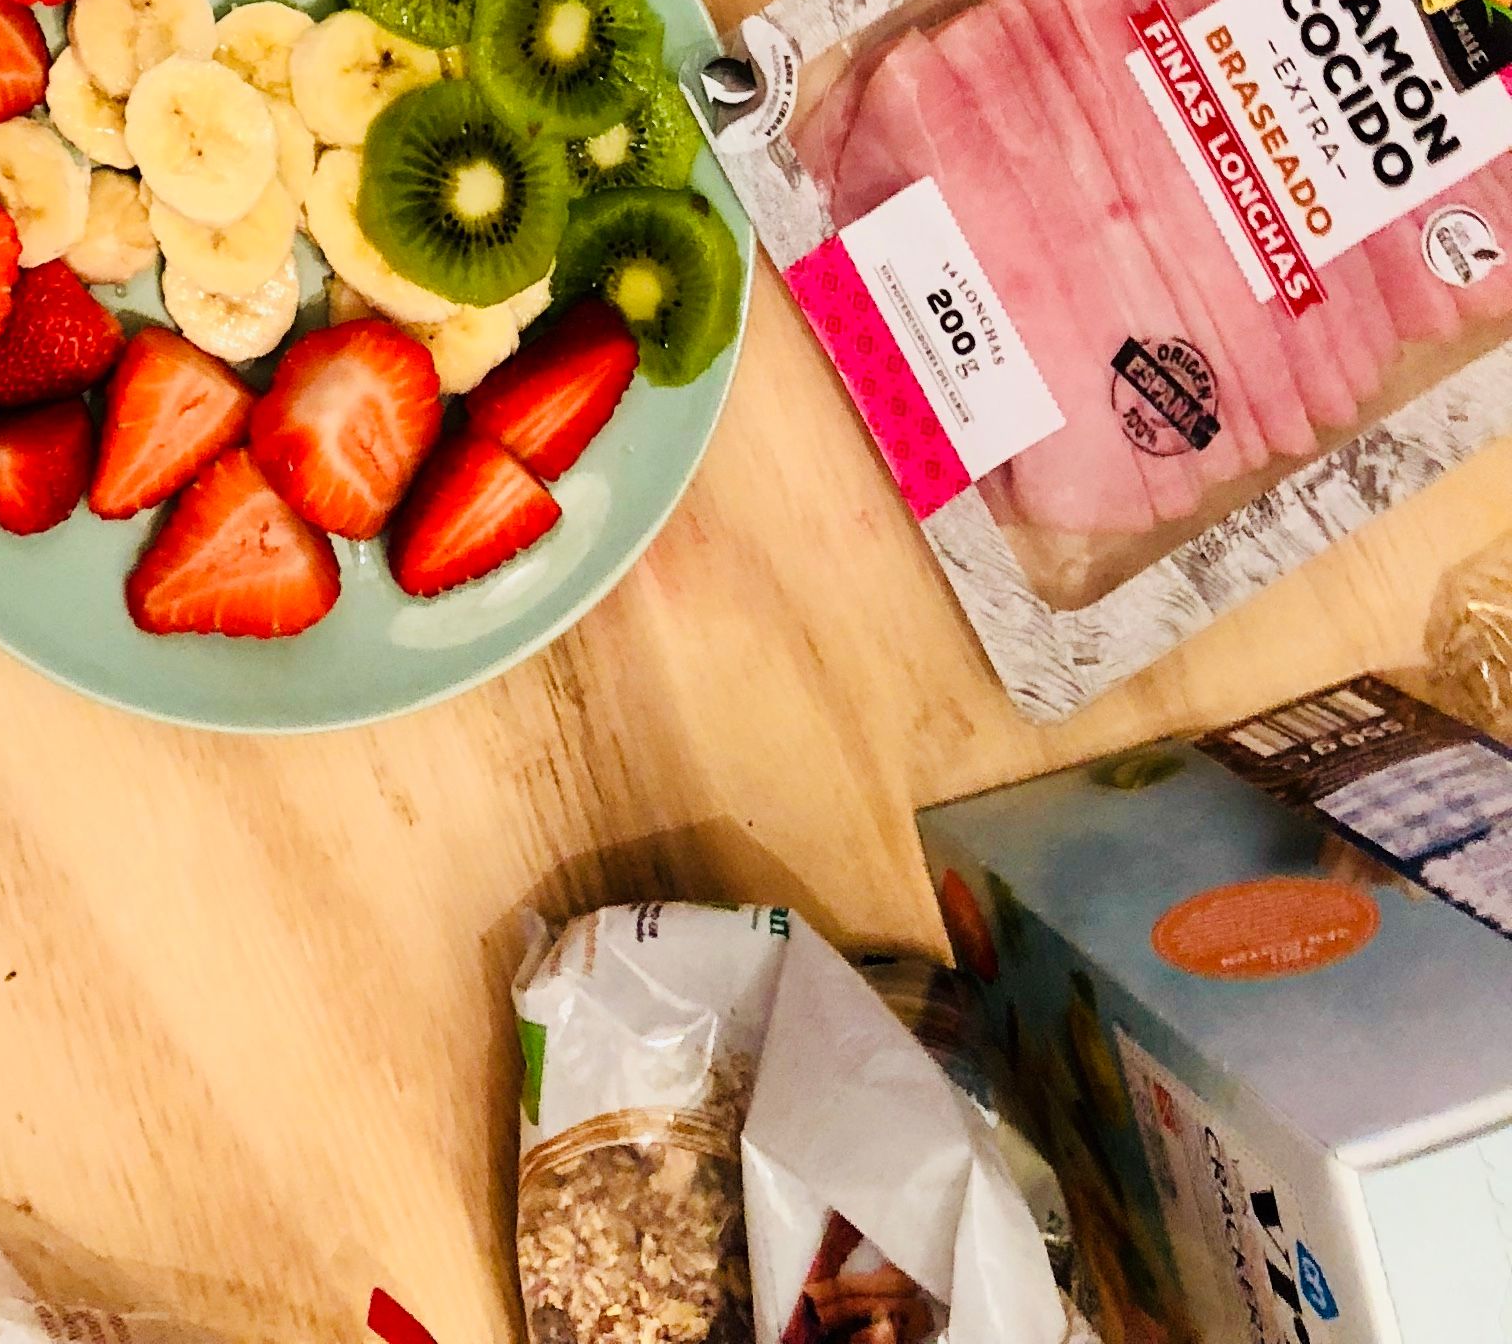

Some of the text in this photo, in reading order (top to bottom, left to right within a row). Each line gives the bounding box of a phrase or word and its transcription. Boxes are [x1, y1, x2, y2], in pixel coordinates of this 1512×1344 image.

[1144, 21, 1311, 301] FINAS LONCHAS
[1204, 25, 1333, 237] BRASEADO
[957, 278, 1005, 366] LONCHAS
[1157, 343, 1213, 401] ORIGEN
